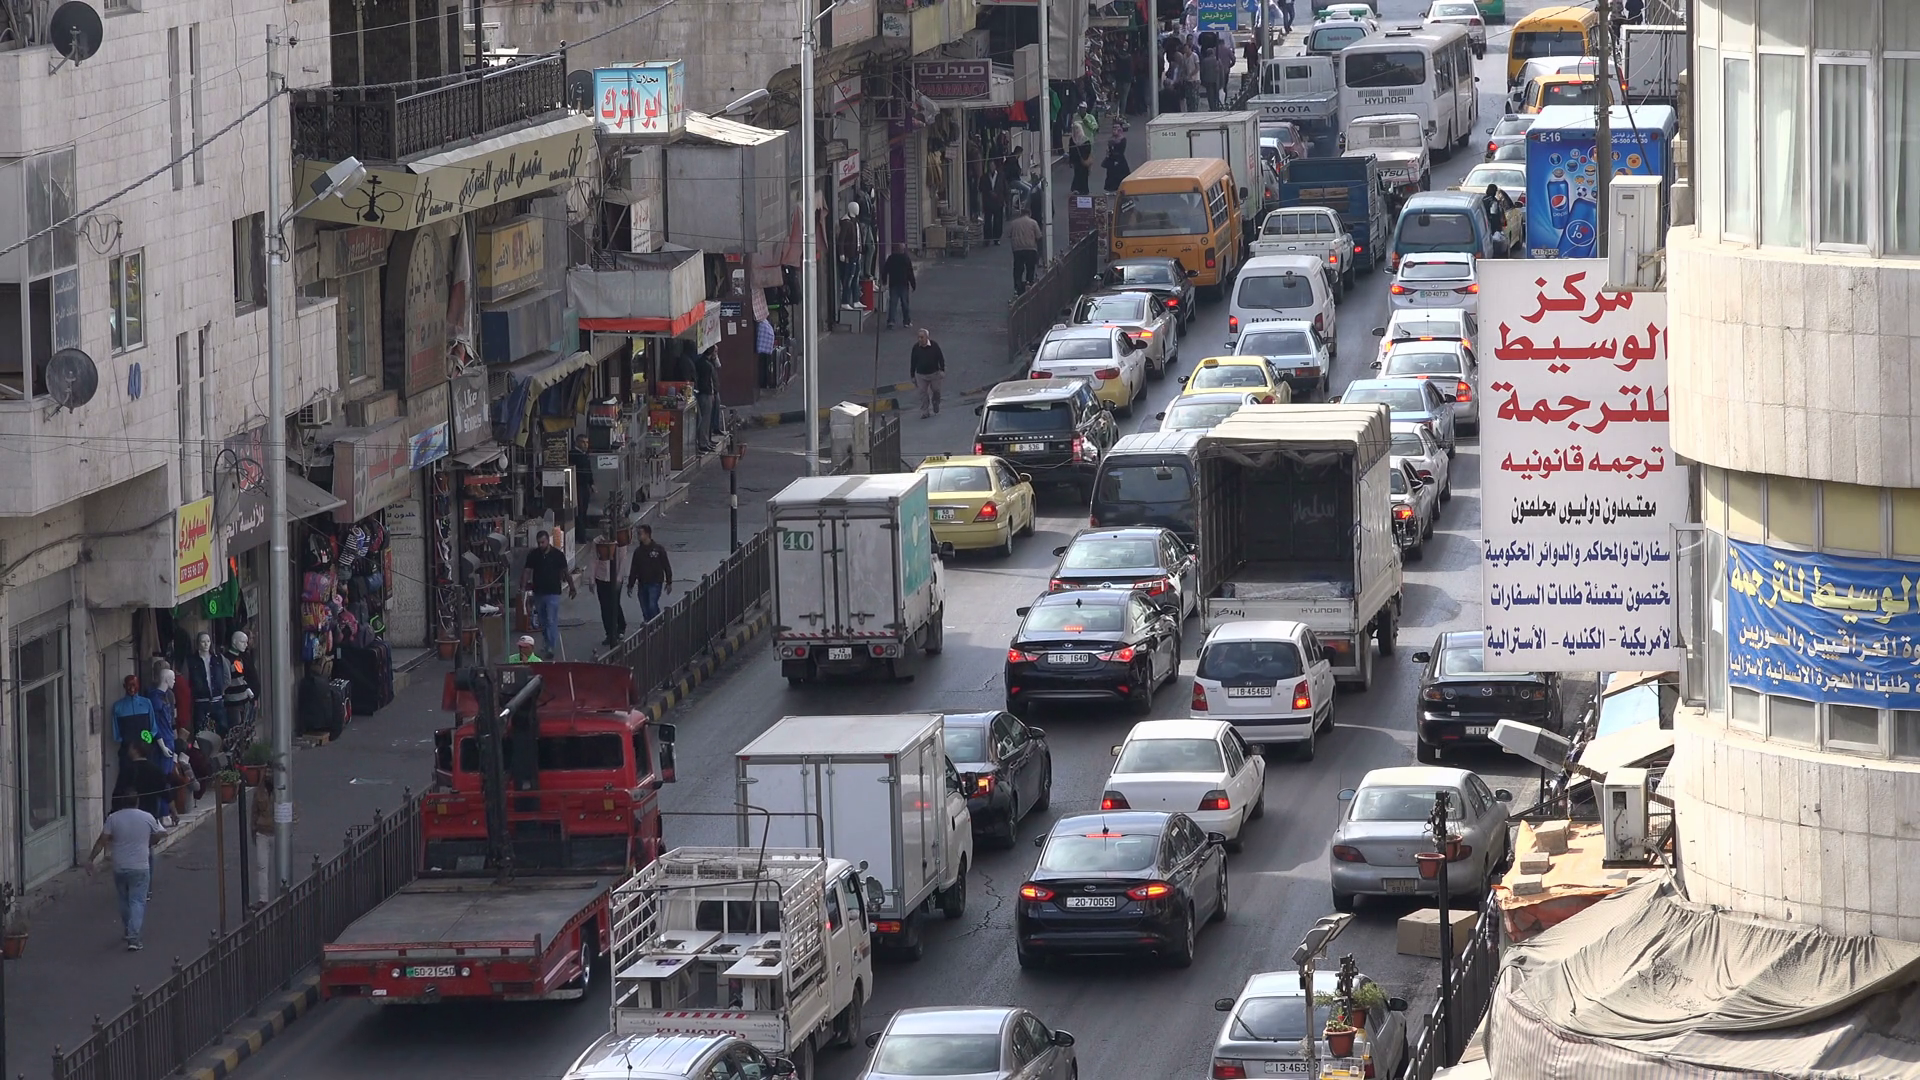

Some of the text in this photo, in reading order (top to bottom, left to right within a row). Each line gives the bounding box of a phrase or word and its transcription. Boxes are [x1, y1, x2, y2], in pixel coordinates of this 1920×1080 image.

[636, 74, 658, 84] محلات
[918, 62, 985, 78] صيدلية
[919, 84, 985, 96] PHARMACY
[1365, 96, 1407, 104] HYUNDAI
[601, 86, 641, 129] الترك
[642, 88, 661, 129] ابو
[1265, 105, 1311, 113] TOYOTA
[1539, 132, 1560, 142] E-16
[1520, 271, 1633, 324] مركز
[1500, 445, 1664, 481] ترجمه قانونيه
[1511, 494, 1557, 525] محلفون
[1601, 494, 1657, 525] معتمدون
[783, 532, 813, 550] 40
[1484, 539, 1670, 568] سفارات والمحاكم والدوائر الحكومية
[1729, 547, 1806, 609] للترجمة
[1490, 582, 1544, 612] السفارات
[1547, 583, 1583, 606] طلبات
[1626, 581, 1670, 612] ختصون
[1486, 624, 1670, 656] لأمريكية الكنديه الأسترالية
[1738, 617, 1805, 656] والسوريين
[1806, 628, 1897, 663] العراقيين
[1765, 657, 1815, 685] الانسانية
[1815, 668, 1861, 693] الهجرة
[1864, 671, 1911, 699] طلبات
[1236, 687, 1270, 696] 18-45463
[1075, 898, 1116, 907] 20-70059
[1275, 1062, 1319, 1072] 13-4632
